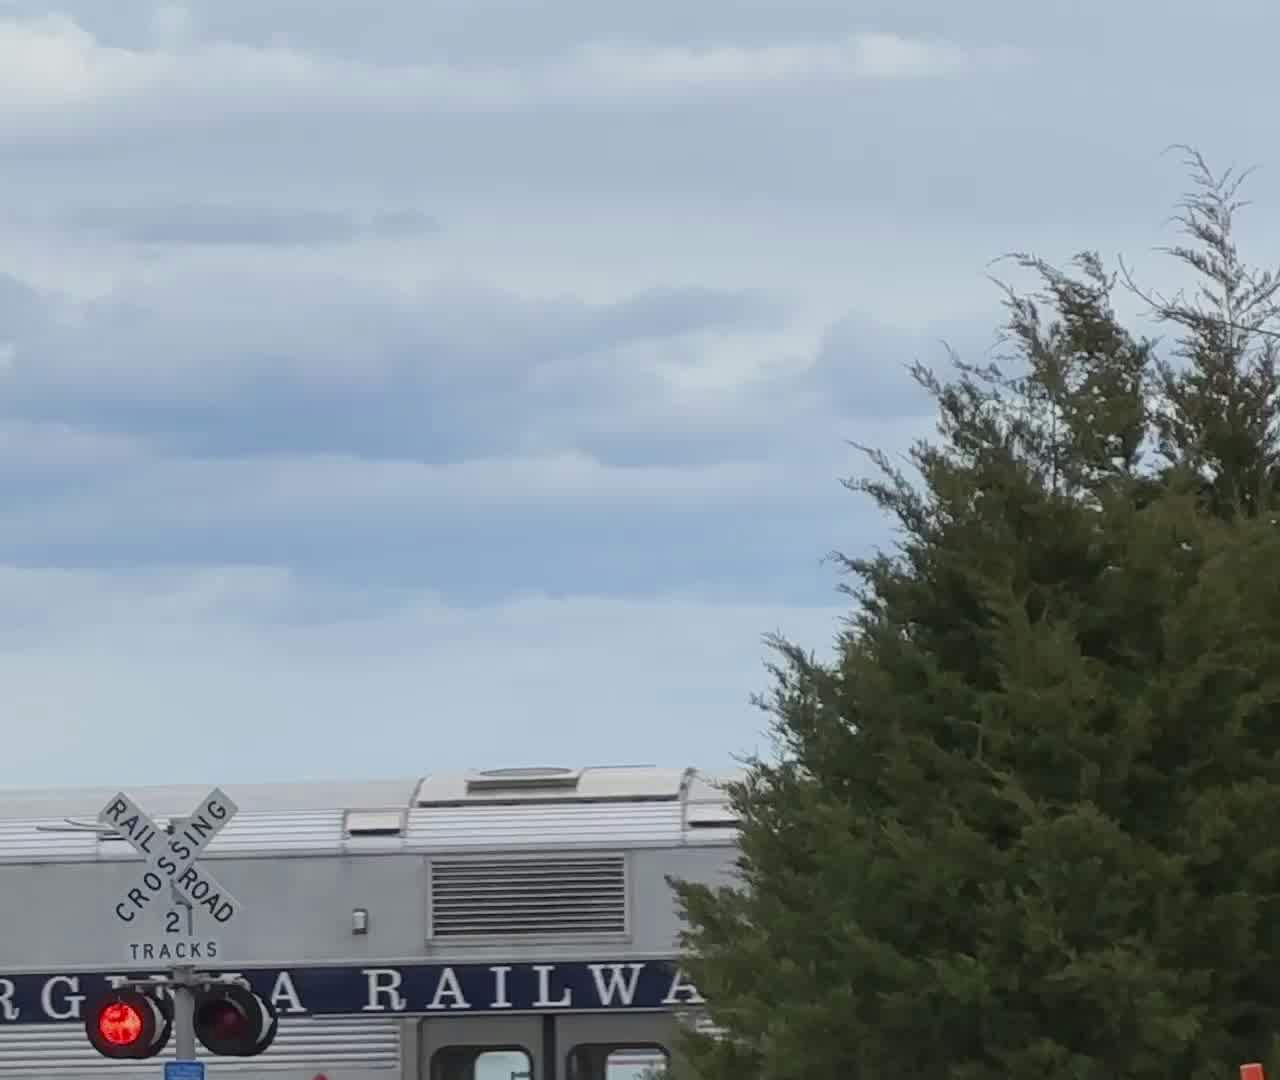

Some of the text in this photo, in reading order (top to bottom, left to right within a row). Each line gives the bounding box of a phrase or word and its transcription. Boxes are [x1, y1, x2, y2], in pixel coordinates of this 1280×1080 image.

[106, 799, 234, 923] RAIL ROAD
[115, 800, 227, 923] CROSSING
[166, 911, 180, 933] 2
[129, 941, 218, 960] TRACKS
[361, 962, 707, 1012] RAILWA
